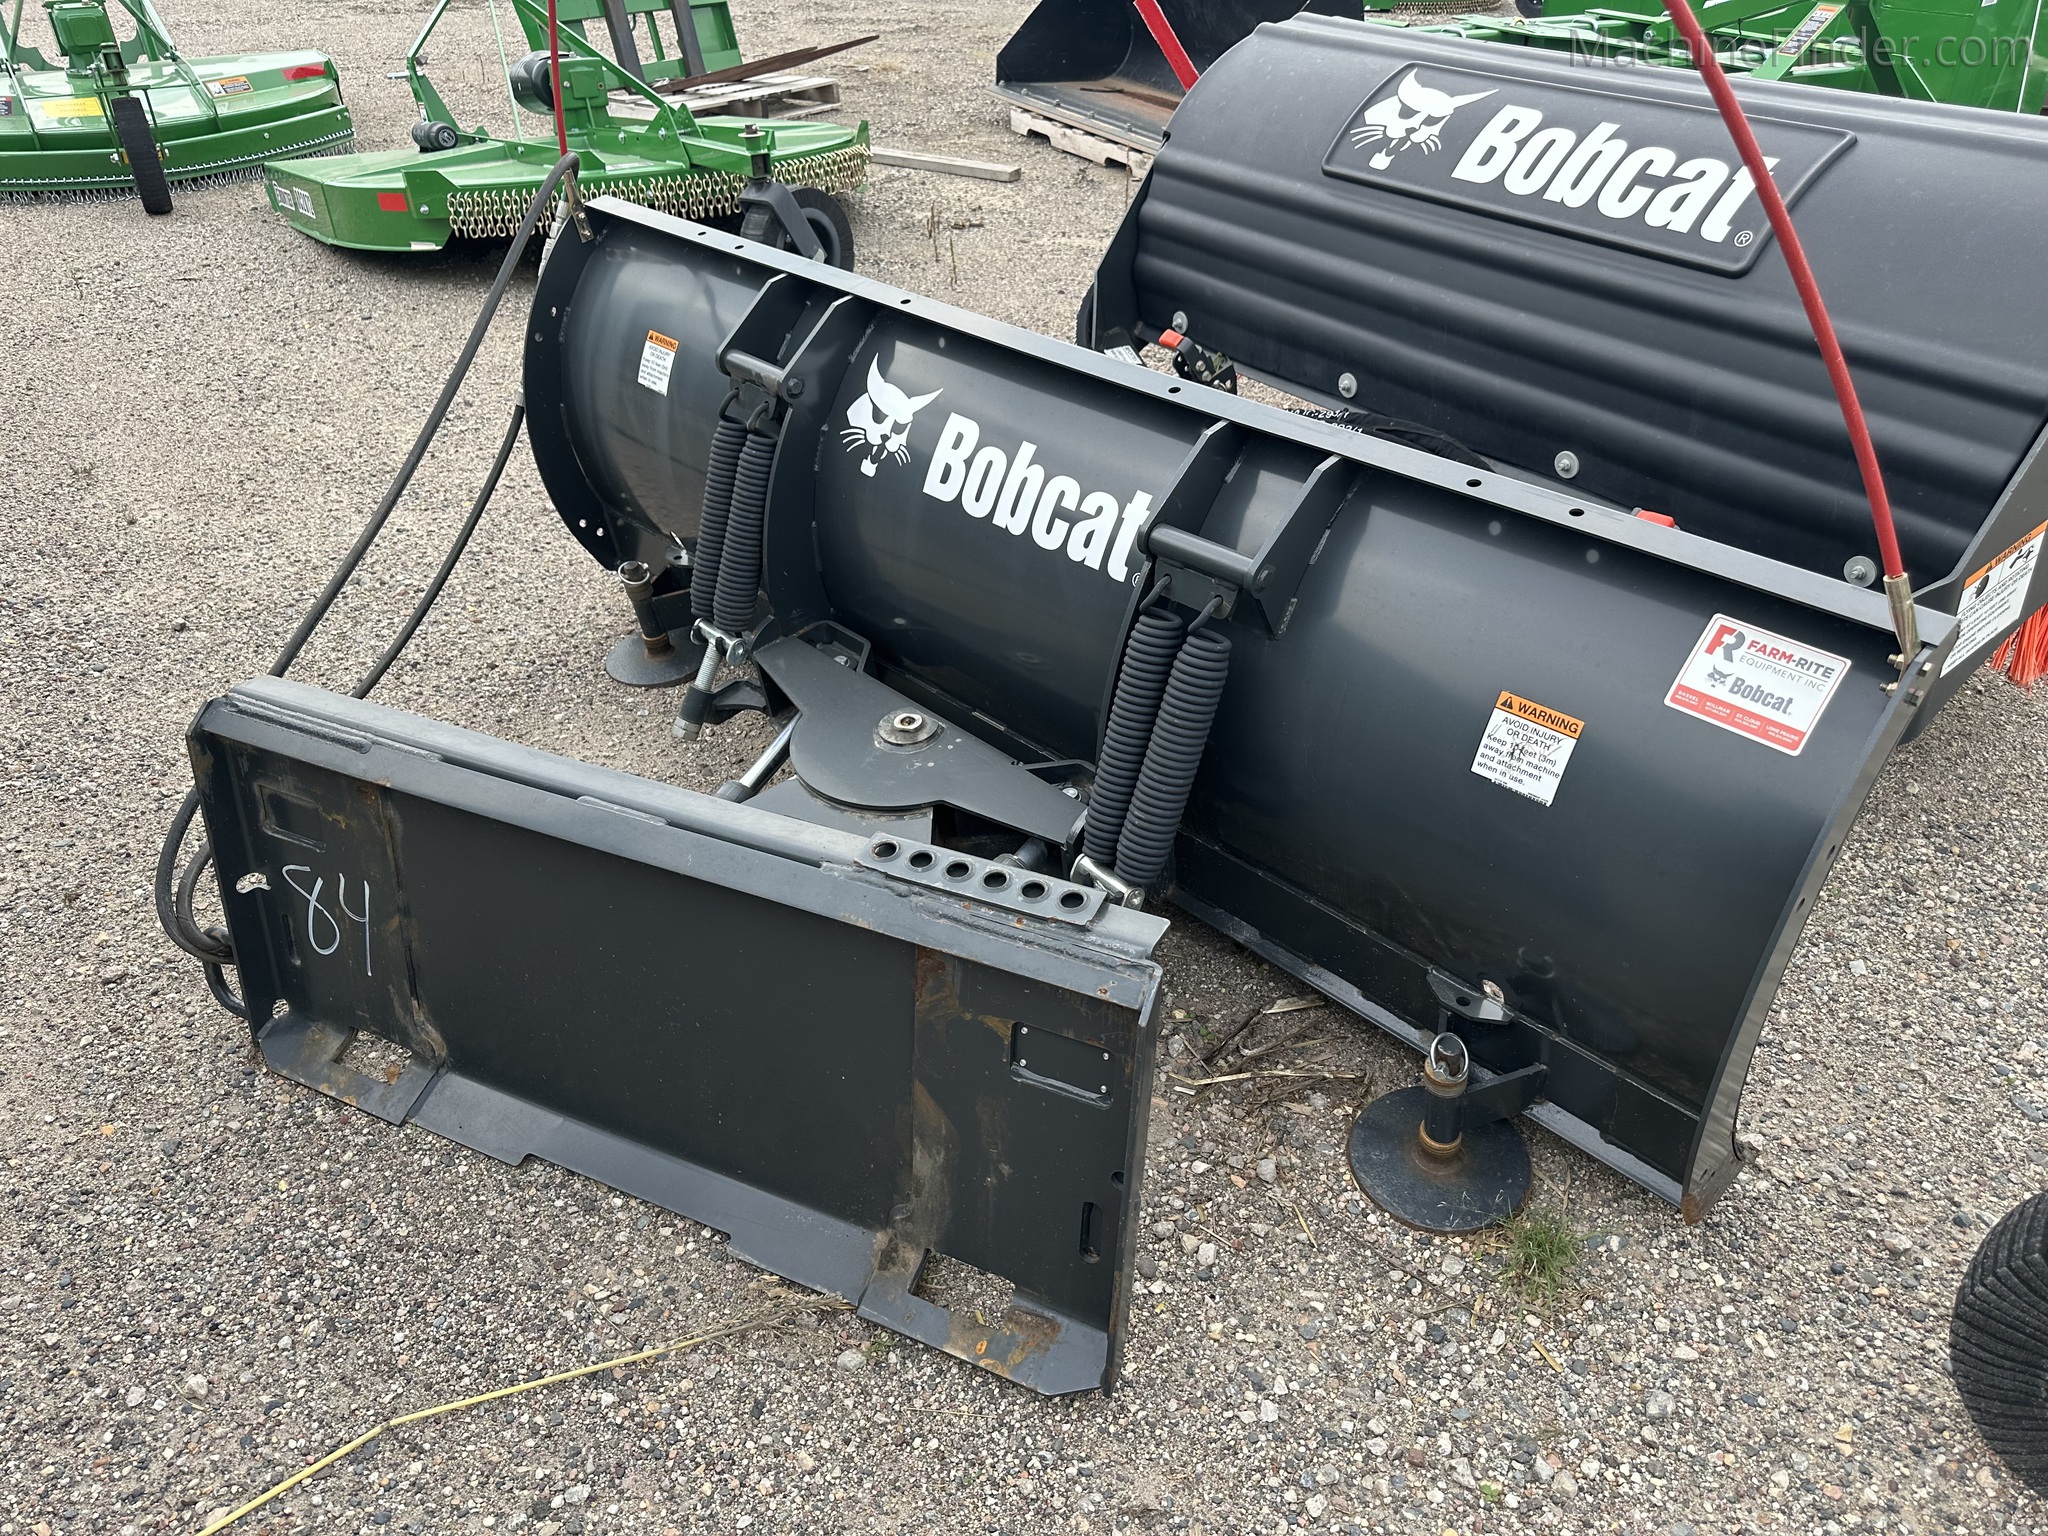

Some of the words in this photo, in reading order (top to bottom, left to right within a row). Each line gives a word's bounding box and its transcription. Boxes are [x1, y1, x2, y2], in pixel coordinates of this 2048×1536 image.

[1450, 103, 1781, 243] Bobcat
[922, 411, 1154, 583] Bobcat
[1739, 654, 1804, 684] EQUIPMENT
[1804, 677, 1826, 693] INC
[1746, 639, 1836, 680] FARM-RITE
[1727, 676, 1794, 715] Bobcat
[1501, 716, 1529, 732] AVOID
[1529, 727, 1562, 746] INJURY
[1518, 701, 1580, 735] WARNING
[1486, 732, 1508, 748] Keep
[1538, 752, 1557, 768] (3m)
[1506, 727, 1521, 739] OR
[1521, 733, 1552, 751] DEATH
[1477, 761, 1498, 774] when
[1499, 768, 1507, 778] in
[1508, 773, 1525, 786] use.
[1479, 750, 1495, 763] and
[1496, 758, 1542, 782] attachment
[1482, 742, 1505, 757] away
[1525, 760, 1561, 779] machine
[282, 864, 372, 977] 84
